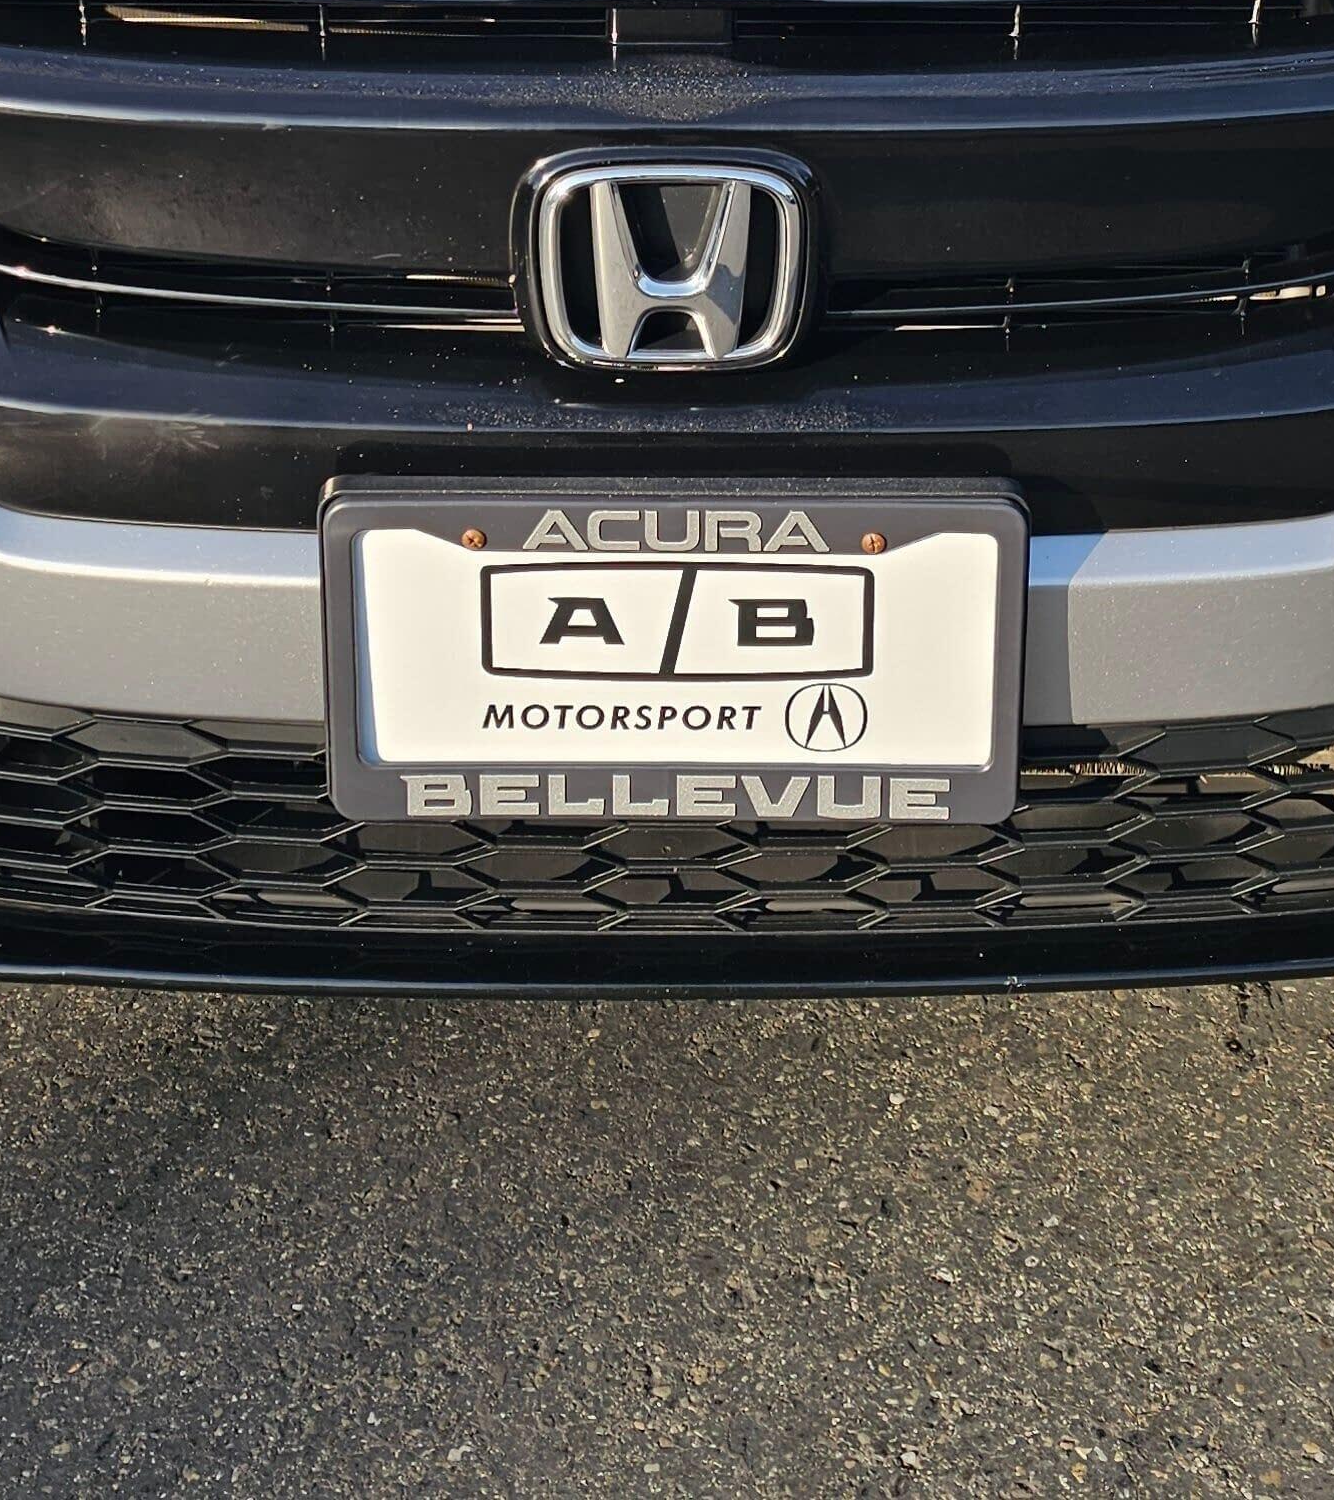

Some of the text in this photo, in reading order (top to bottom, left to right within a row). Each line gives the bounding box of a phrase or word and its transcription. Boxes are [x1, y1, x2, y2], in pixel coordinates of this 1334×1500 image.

[523, 508, 831, 553] ACURA
[539, 596, 816, 647] A B
[481, 702, 762, 732] MOTORSPORT
[400, 773, 952, 821] BELLEVUE
